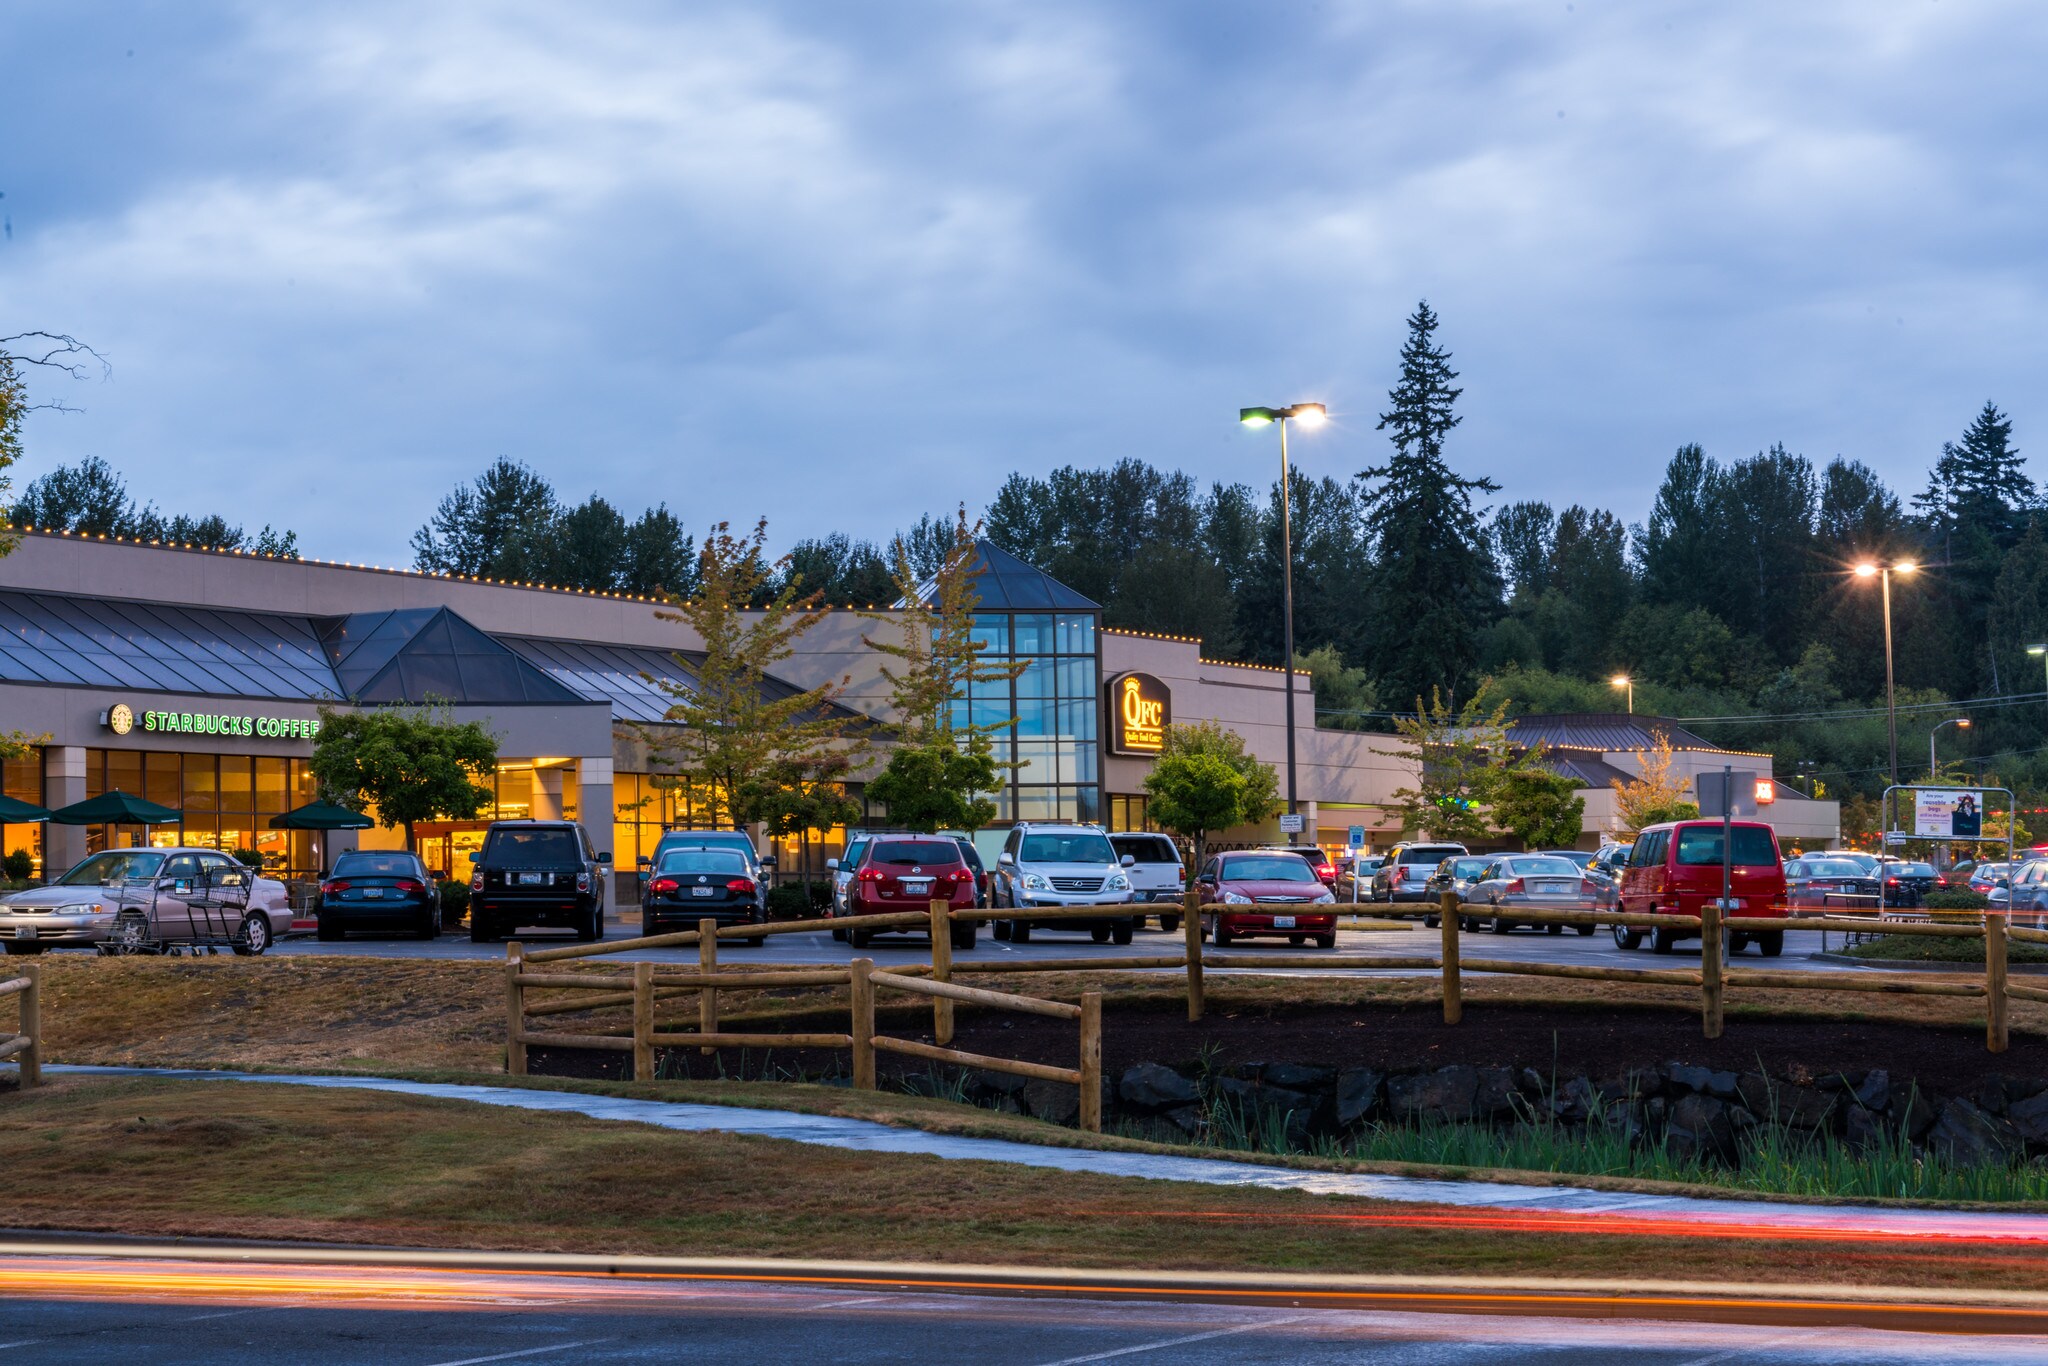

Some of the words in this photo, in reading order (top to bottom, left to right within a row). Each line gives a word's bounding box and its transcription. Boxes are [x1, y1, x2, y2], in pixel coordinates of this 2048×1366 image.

[1124, 689, 1162, 731] QFC
[145, 711, 252, 736] STARBUCKS
[256, 717, 320, 738] COFFEE
[1125, 731, 1139, 743] Quality
[1139, 732, 1149, 742] Food
